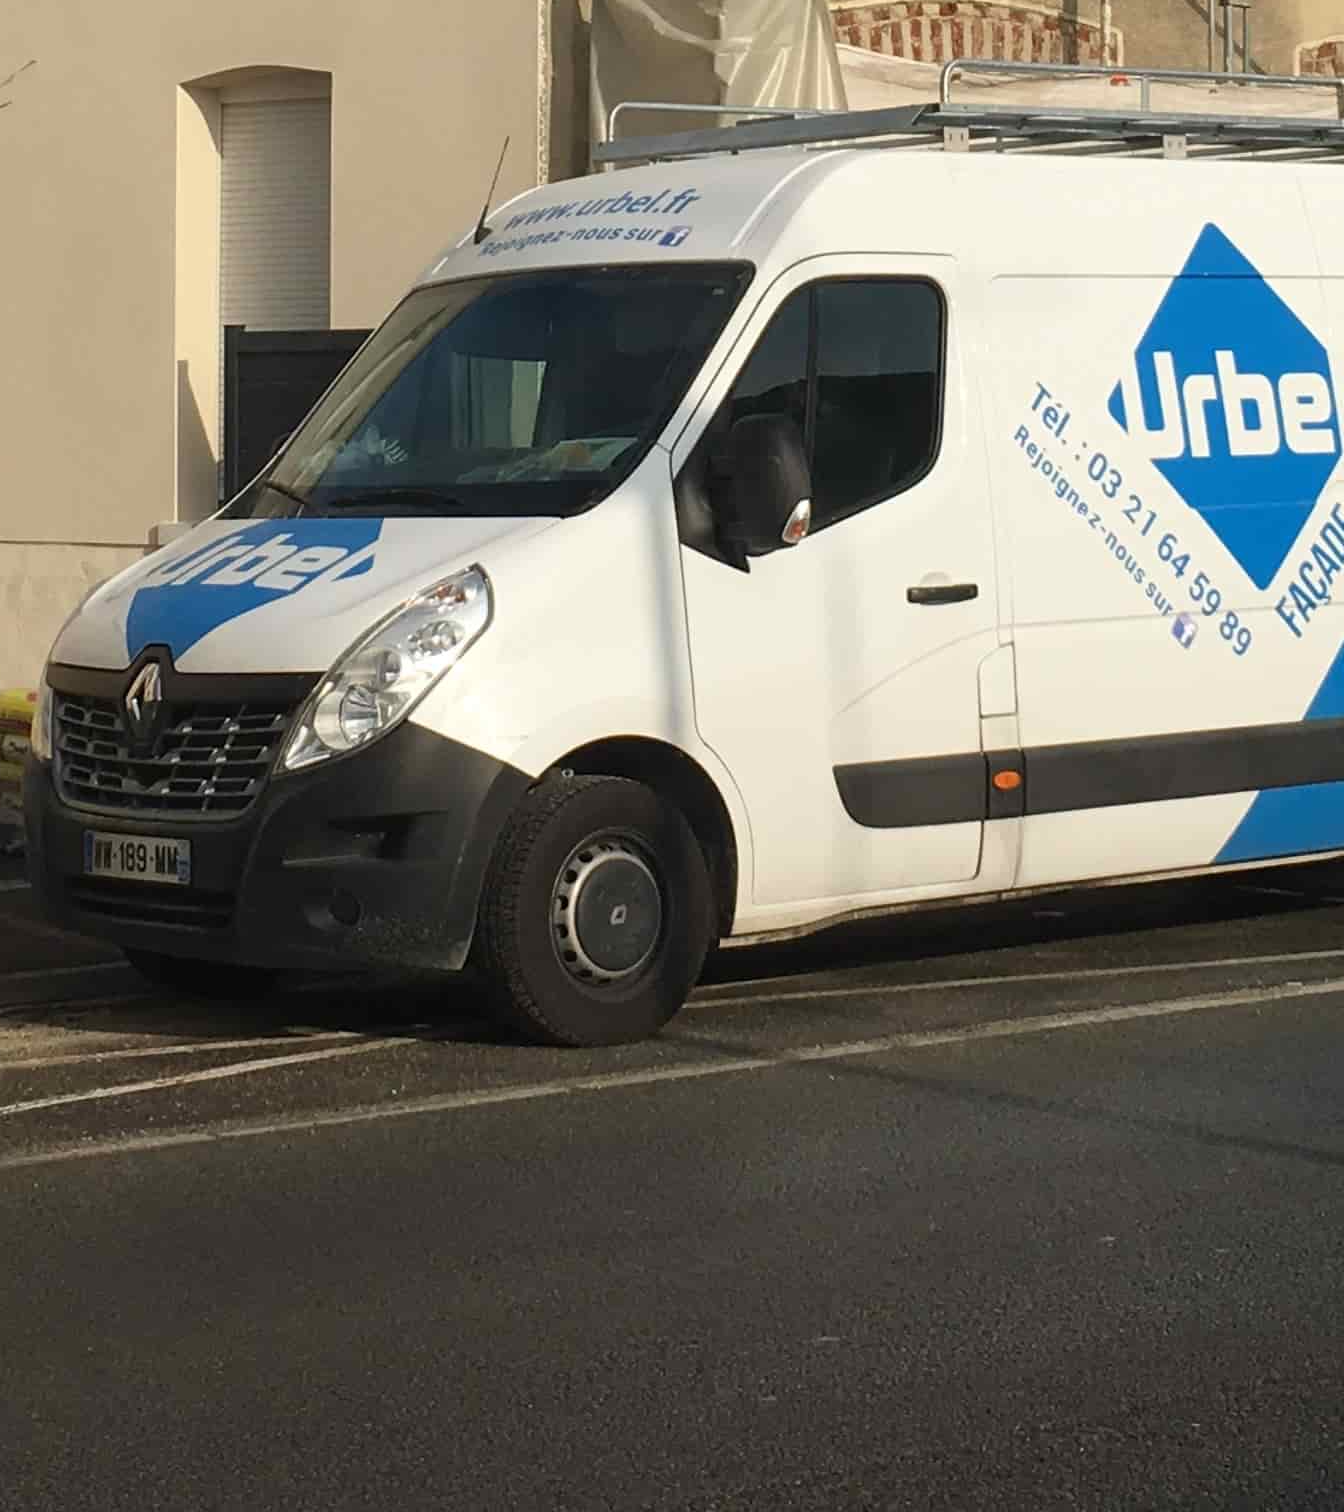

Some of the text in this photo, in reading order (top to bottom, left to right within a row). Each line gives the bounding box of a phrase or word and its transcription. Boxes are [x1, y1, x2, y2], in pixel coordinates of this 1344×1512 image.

[504, 188, 702, 231] www.urbel.fr
[623, 226, 663, 242] sur
[1013, 424, 1146, 585] Rejoignez-nous
[1144, 581, 1174, 617] sur
[140, 532, 380, 591] Urbel
[1087, 452, 1123, 499] 03
[1122, 493, 1158, 537] 21
[1156, 533, 1192, 578] 64
[1188, 571, 1222, 617] 59
[1218, 610, 1252, 656] 89
